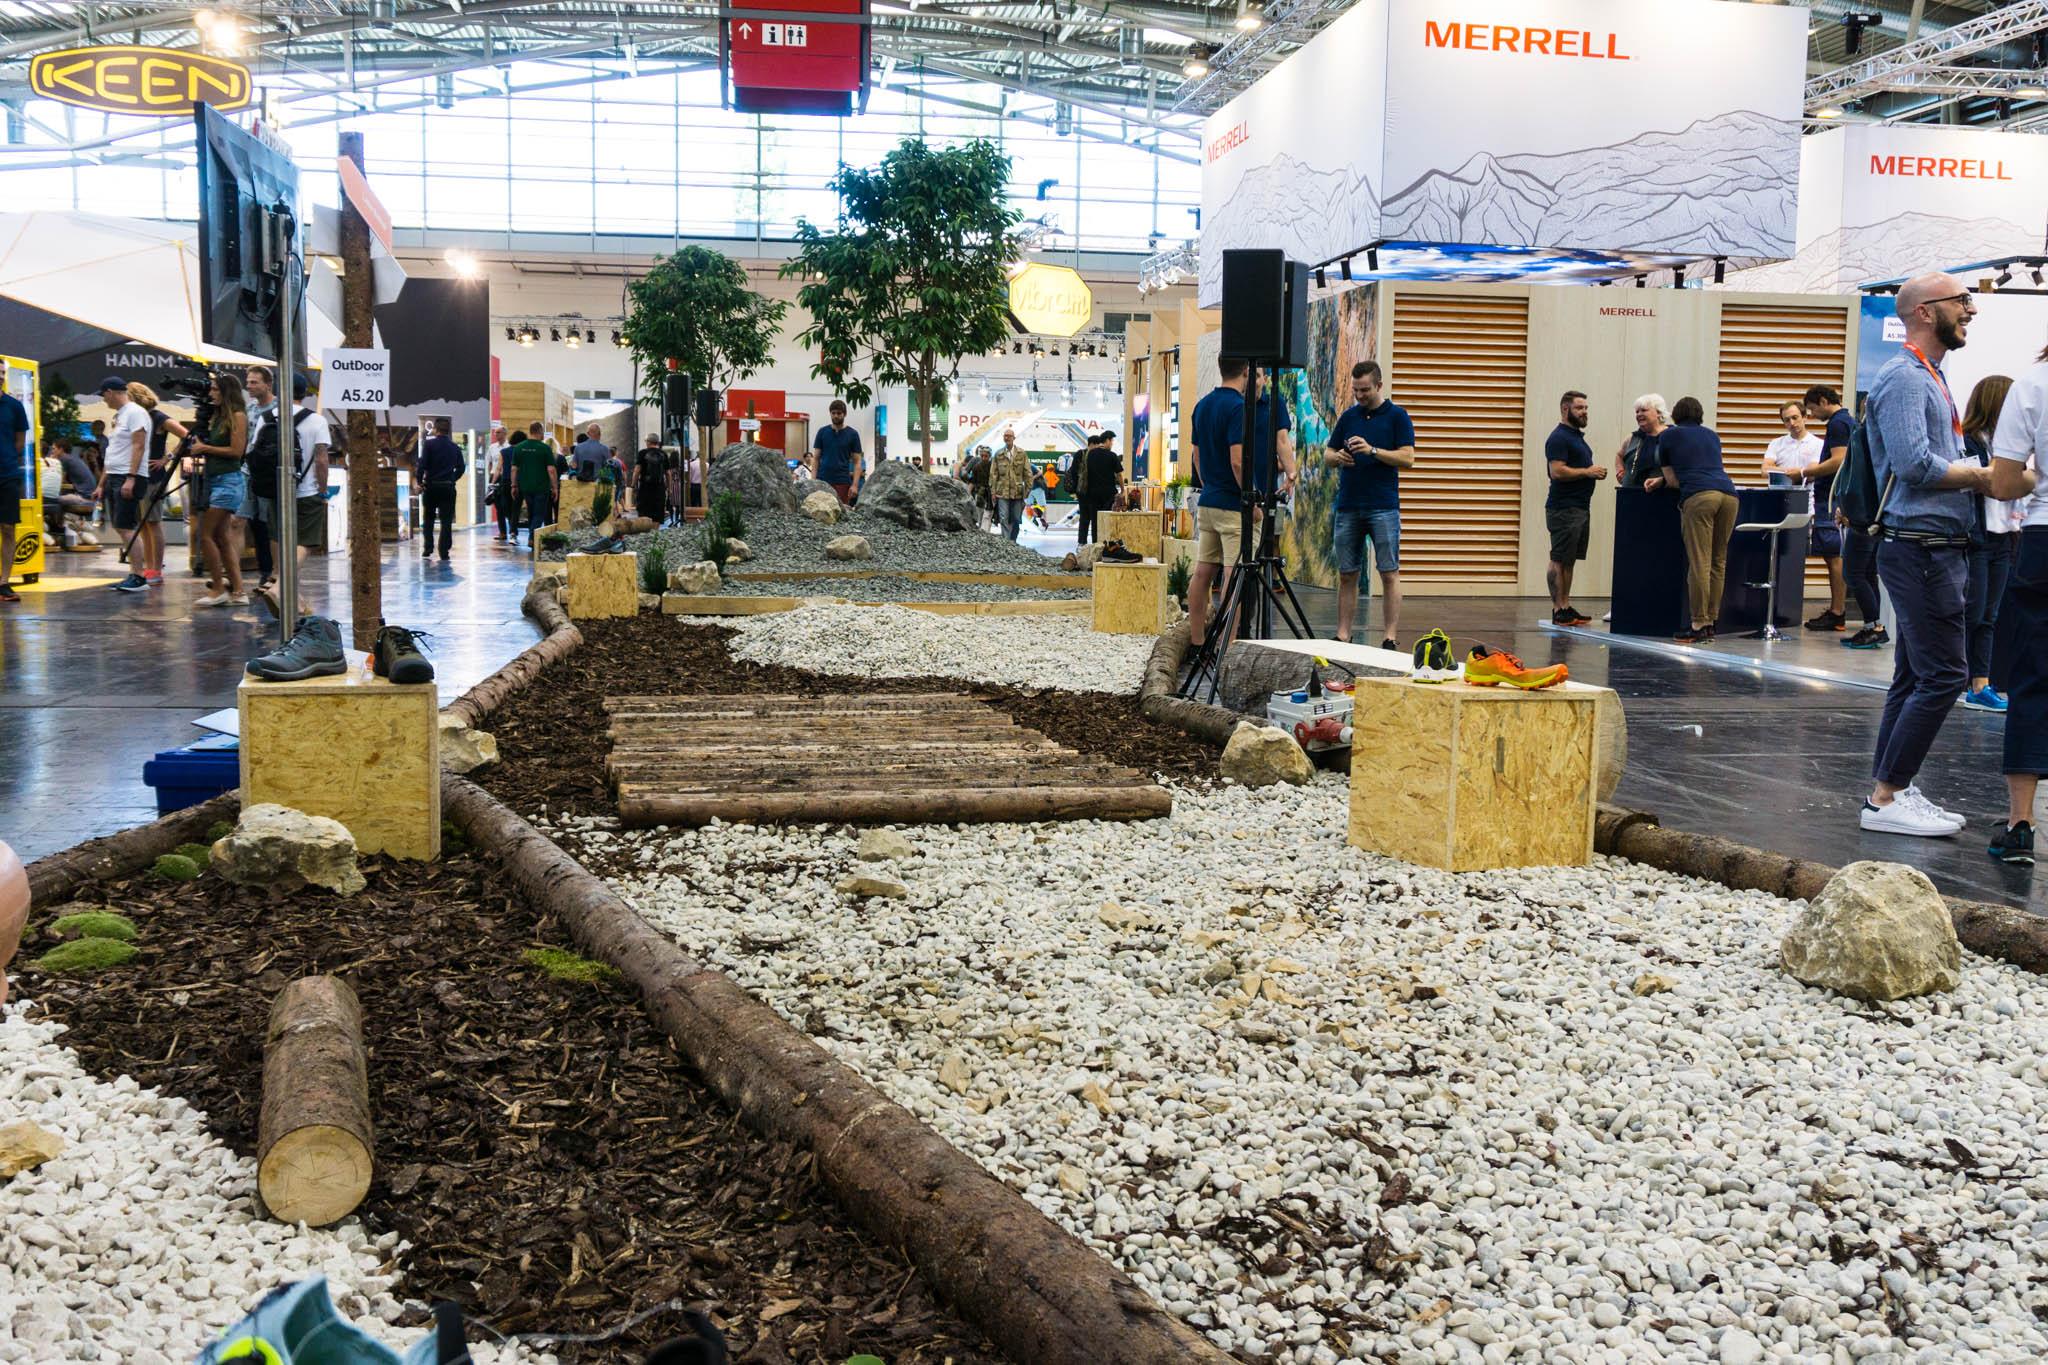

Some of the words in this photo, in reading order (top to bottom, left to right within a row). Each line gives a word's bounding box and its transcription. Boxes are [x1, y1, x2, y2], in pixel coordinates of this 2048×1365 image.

[1424, 20, 1630, 60] MERRELL
[42, 57, 240, 104] KEEN
[1207, 120, 1250, 164] MERRELL
[1870, 155, 2013, 180] MERRELL
[1600, 307, 1656, 317] MERRELL
[106, 354, 191, 369] HANDM
[332, 360, 384, 371] OutDoor
[341, 388, 384, 402] A5.20
